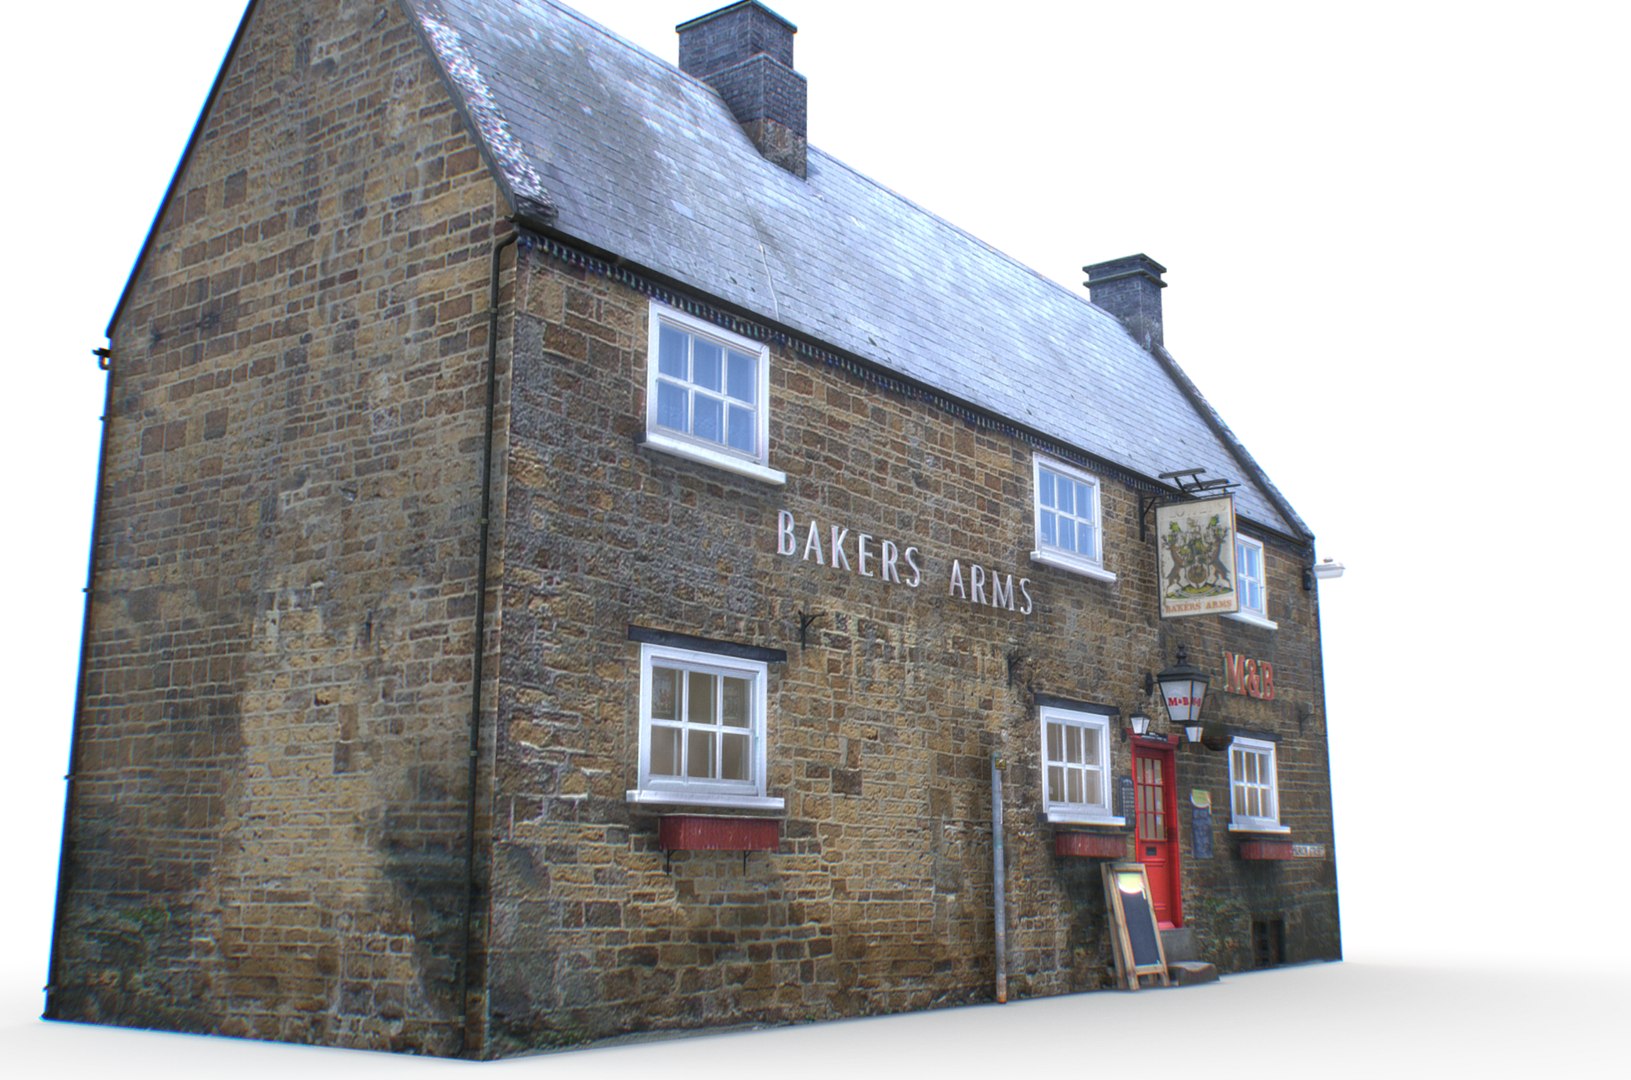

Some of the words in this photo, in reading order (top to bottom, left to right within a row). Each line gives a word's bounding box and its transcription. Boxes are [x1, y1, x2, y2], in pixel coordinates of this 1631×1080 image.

[776, 509, 921, 588] BAKERS
[949, 559, 1033, 615] ARMS
[1165, 602, 1202, 613] BAKERS
[1205, 599, 1232, 609] ARMS
[1223, 651, 1275, 701] M&B
